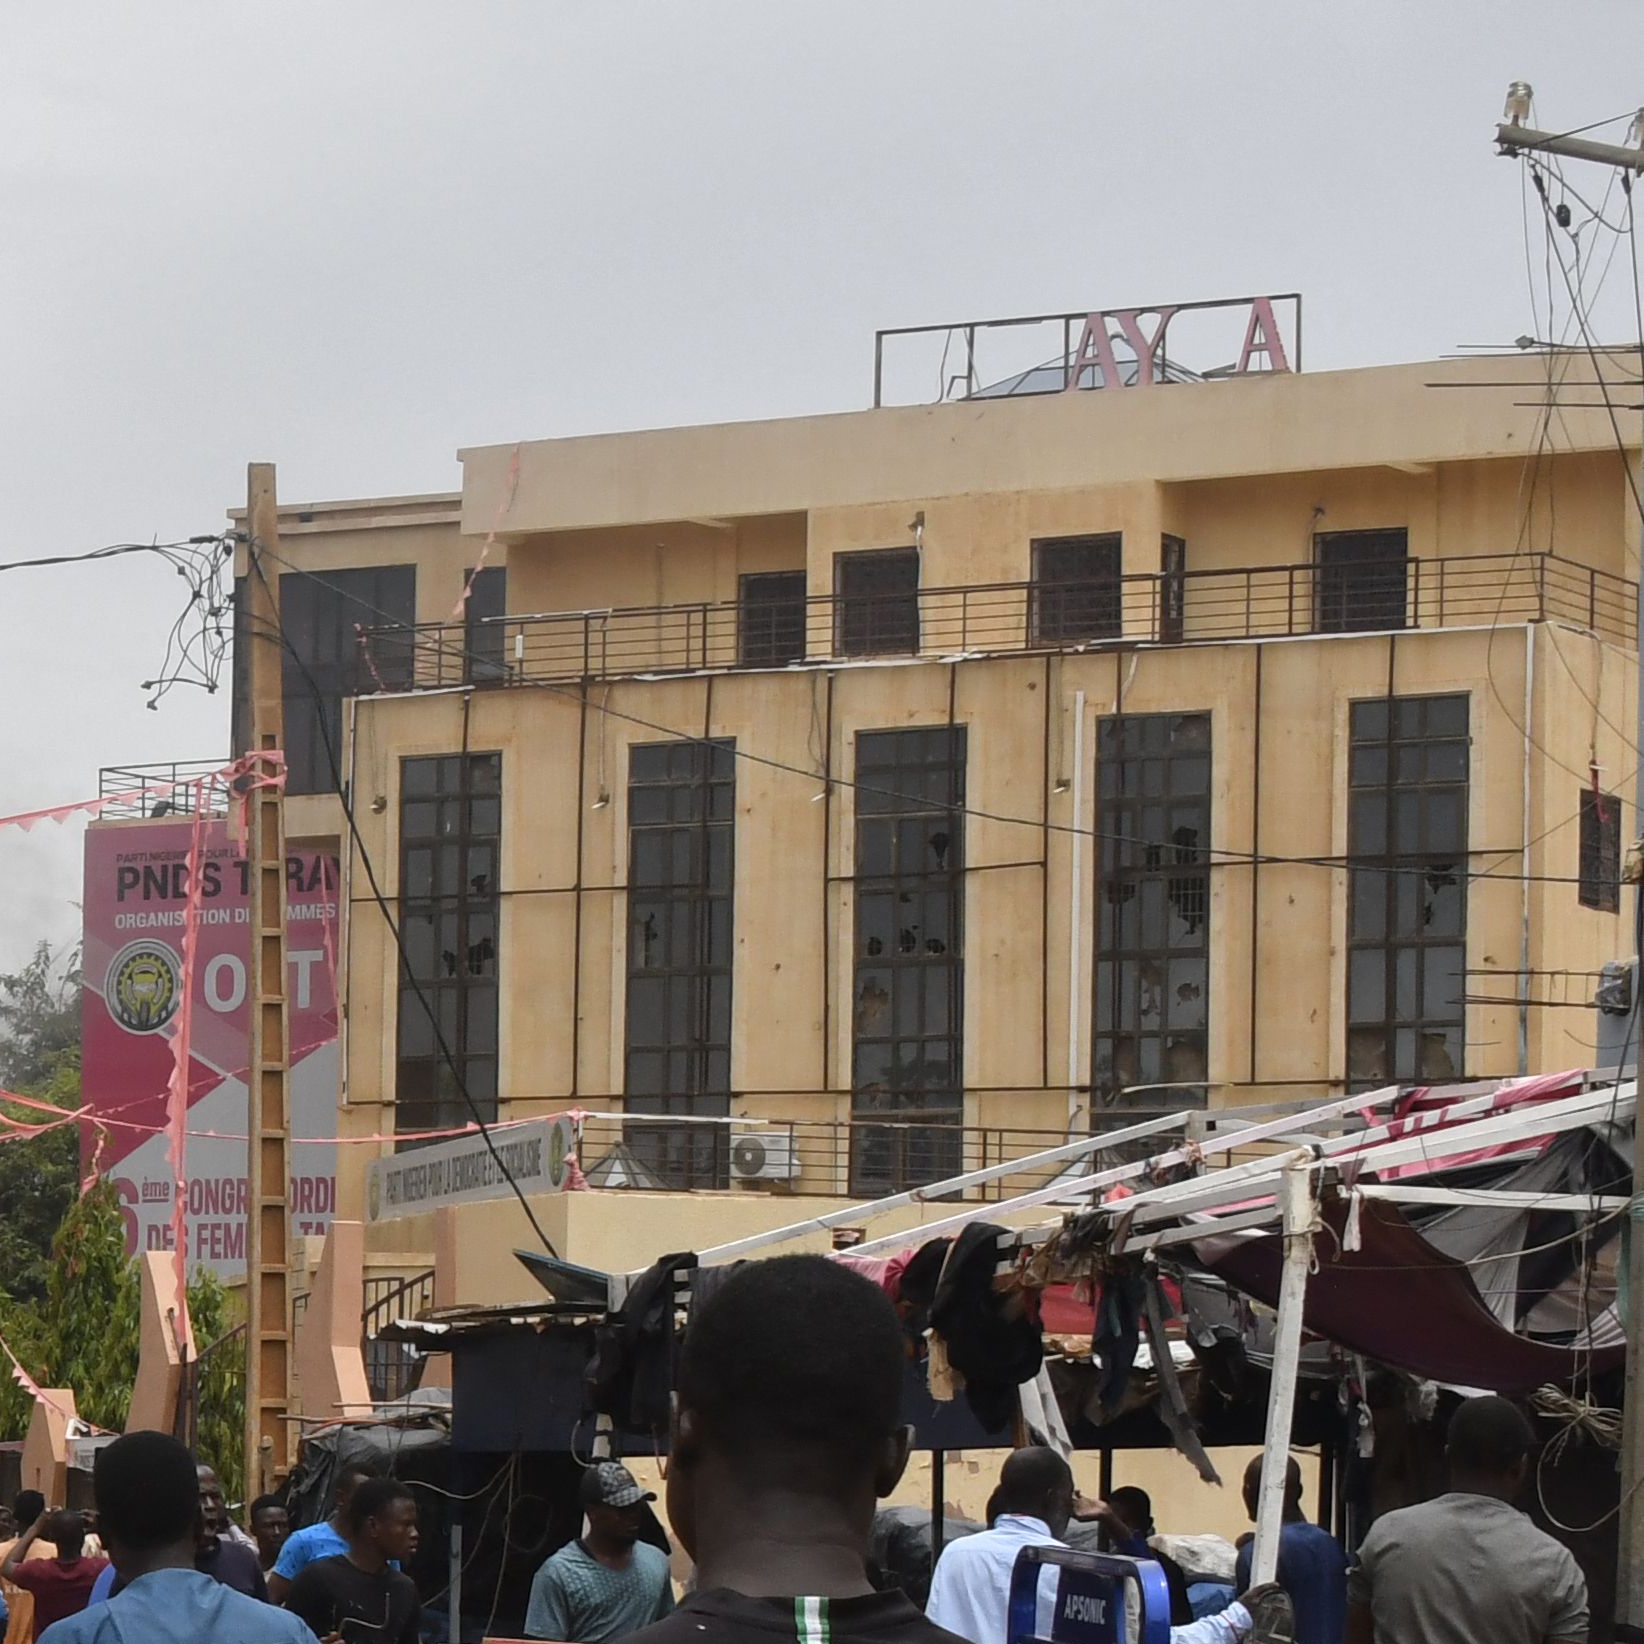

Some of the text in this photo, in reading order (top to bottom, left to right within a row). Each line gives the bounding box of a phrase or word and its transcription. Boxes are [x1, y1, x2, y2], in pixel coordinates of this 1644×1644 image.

[117, 862, 222, 902] PNDS
[115, 908, 230, 929] ORGANISION
[286, 903, 336, 921] MMES
[1064, 1594, 1107, 1625] APSONIC
